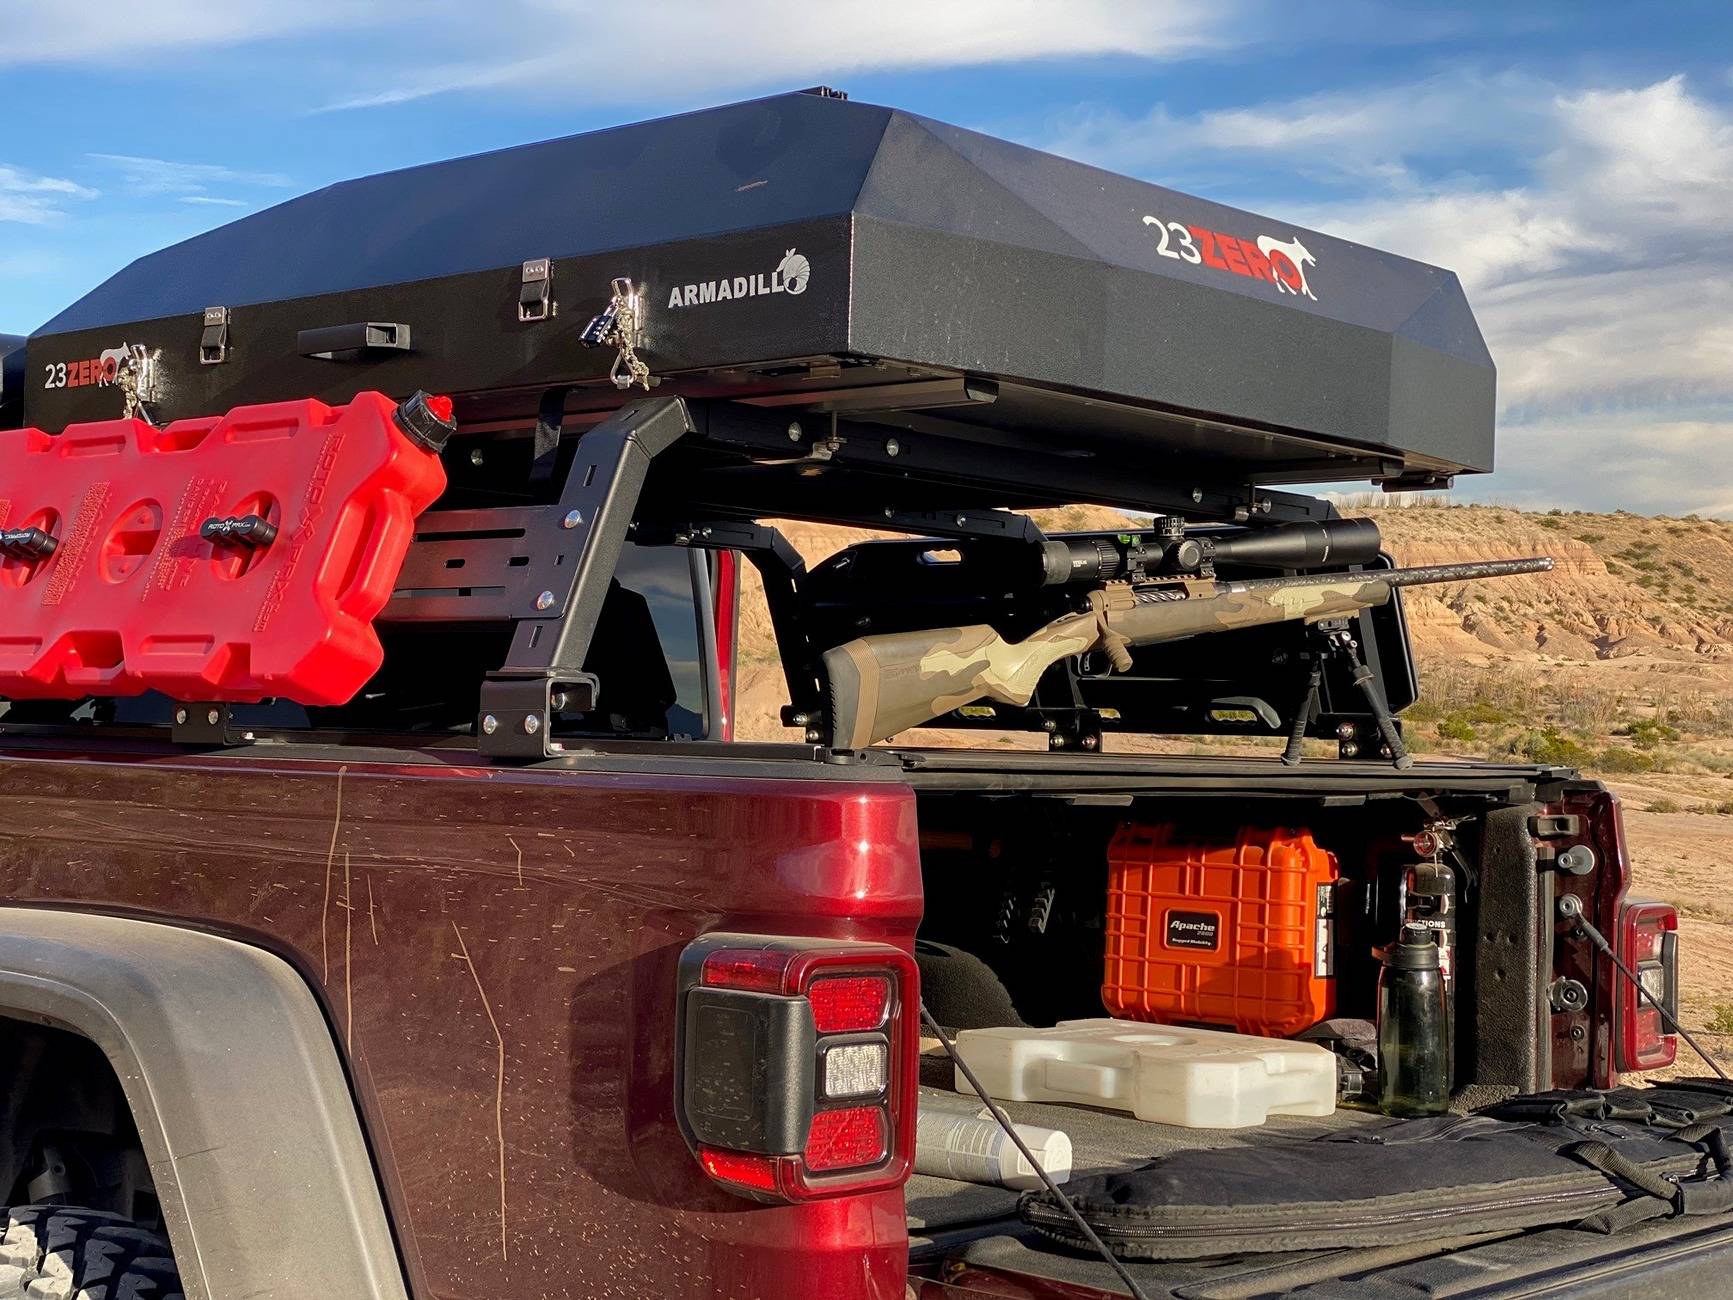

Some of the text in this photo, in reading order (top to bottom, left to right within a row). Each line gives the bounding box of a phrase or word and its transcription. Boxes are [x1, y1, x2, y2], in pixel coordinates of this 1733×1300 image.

[1142, 215, 1302, 291] 23ZERO
[44, 356, 116, 389] 23ZERO
[1170, 920, 1216, 932] Apache
